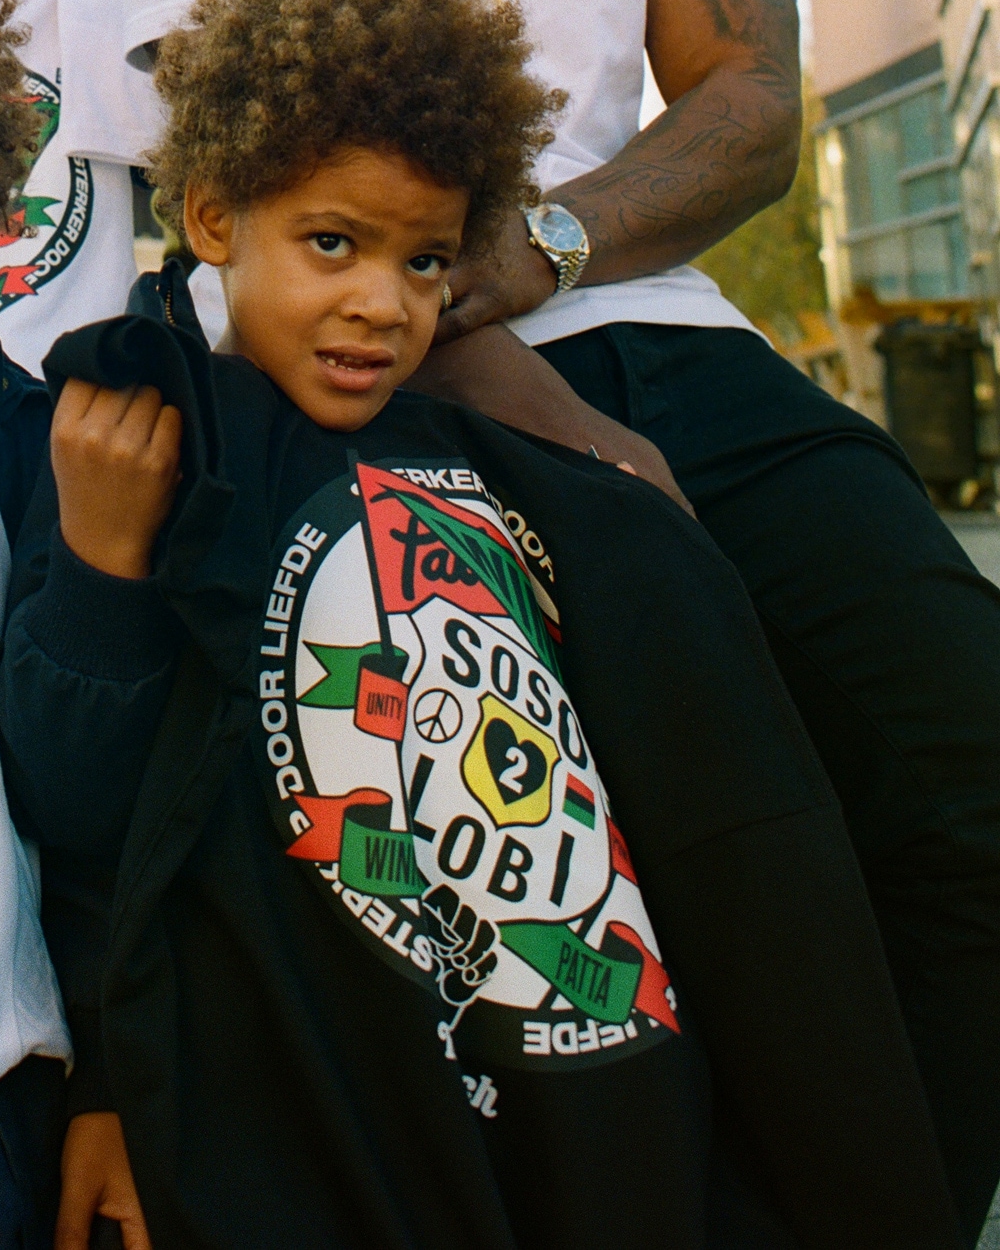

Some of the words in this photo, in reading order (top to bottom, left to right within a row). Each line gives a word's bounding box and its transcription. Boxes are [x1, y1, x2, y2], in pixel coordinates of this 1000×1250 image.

[390, 468, 491, 499] RKER
[260, 522, 328, 657] LIEFDE
[366, 691, 403, 722] UNITY
[442, 618, 589, 770] SOSO
[259, 669, 305, 800] DOOR
[498, 745, 529, 795] 2
[409, 752, 576, 908] LOBI
[555, 940, 613, 1008] PATTA
[522, 1016, 639, 1056] IEFDE
